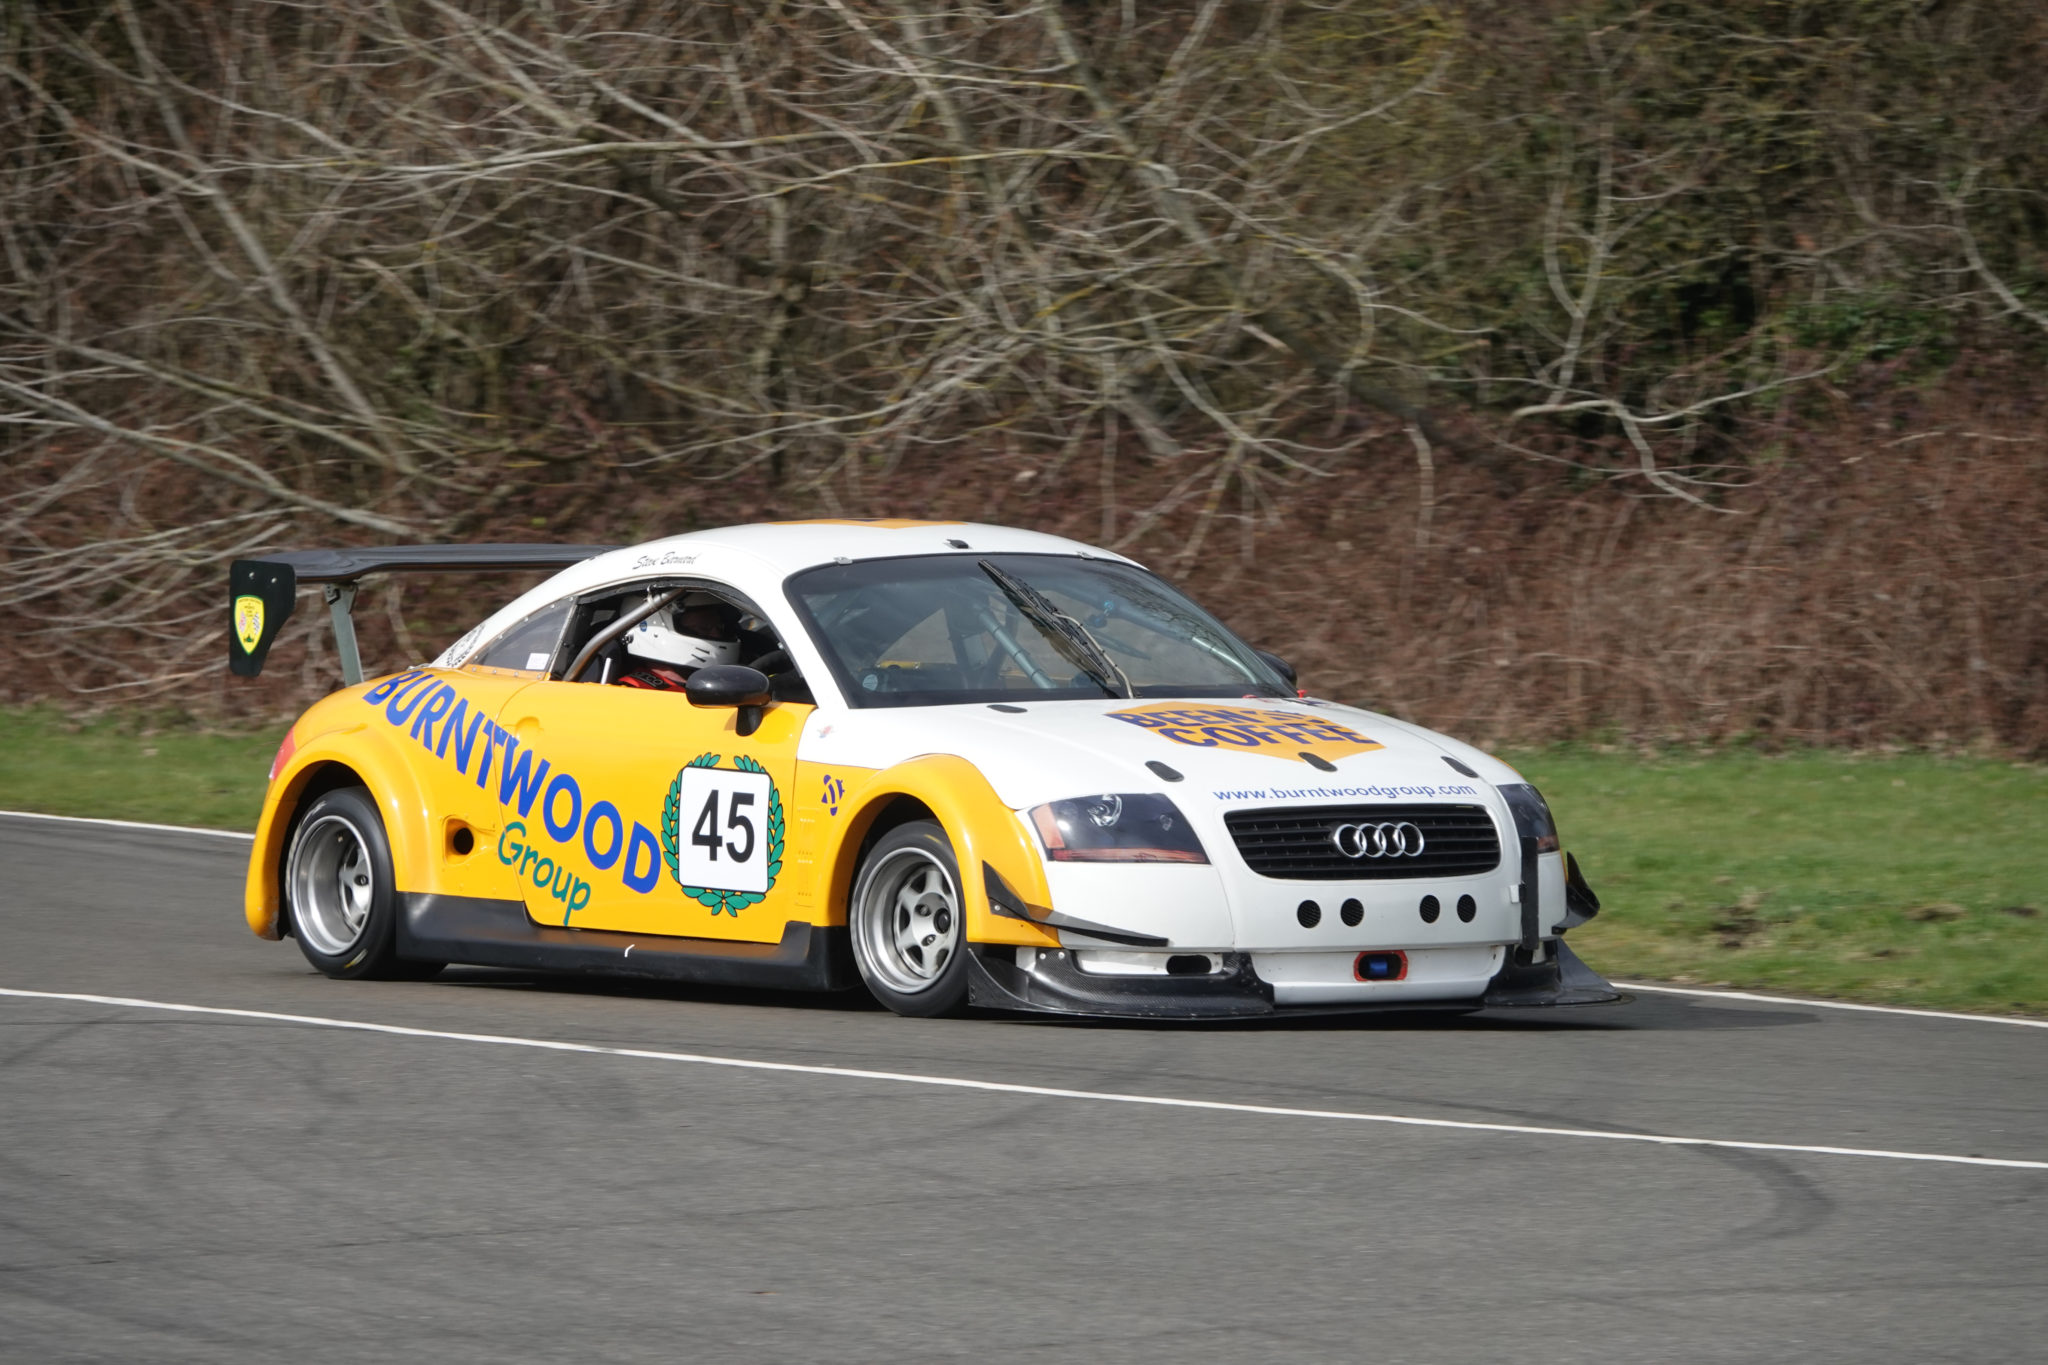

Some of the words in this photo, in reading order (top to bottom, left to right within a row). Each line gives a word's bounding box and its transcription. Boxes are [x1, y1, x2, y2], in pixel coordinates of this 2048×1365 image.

[1159, 722, 1380, 747] COFFEE
[362, 670, 661, 894] BURNTWOOD
[1213, 784, 1478, 800] www.burntwoodgroup.com
[692, 789, 755, 863] 45
[498, 821, 591, 926] Group
